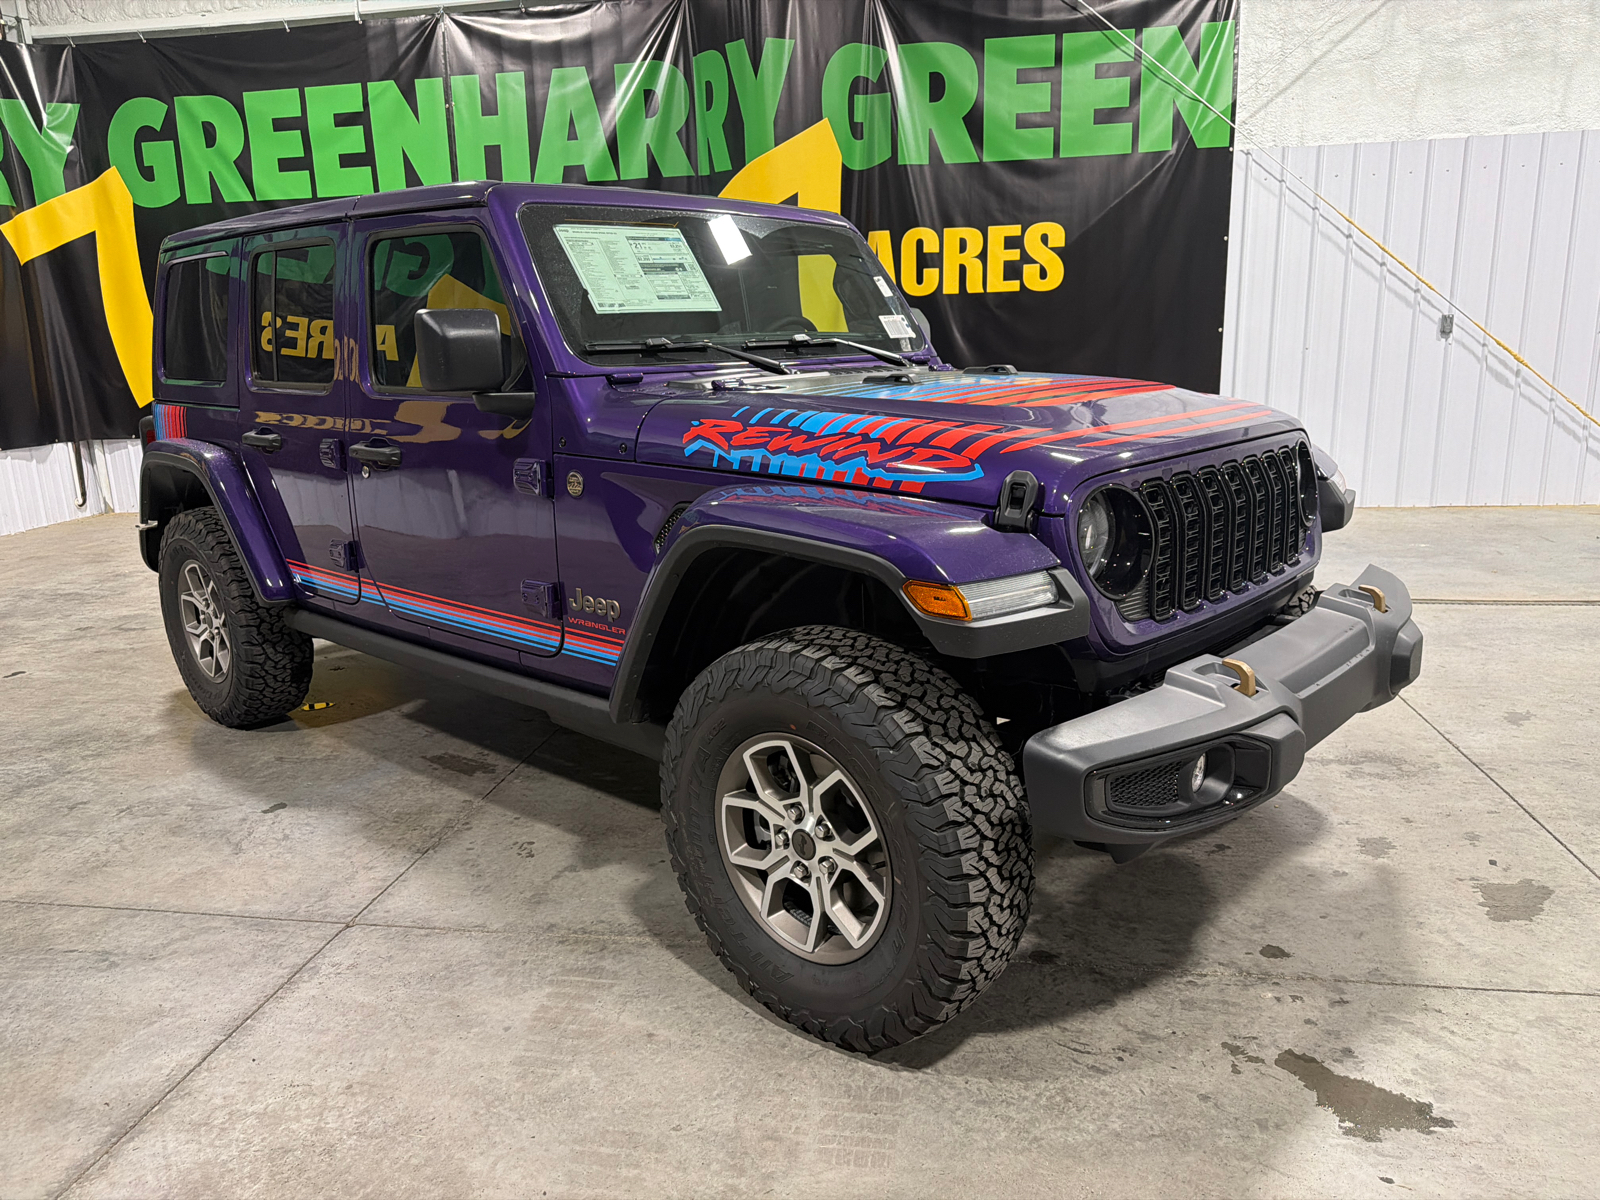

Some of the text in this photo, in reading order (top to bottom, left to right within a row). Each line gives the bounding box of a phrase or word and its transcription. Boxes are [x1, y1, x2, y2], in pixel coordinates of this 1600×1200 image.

[451, 20, 1236, 184] HARRY GREEN
[107, 77, 456, 208] GREEN
[867, 221, 1066, 297] ACRES
[683, 418, 973, 468] REWIND
[568, 587, 621, 623] Jeep
[568, 616, 626, 636] WRANGLER
